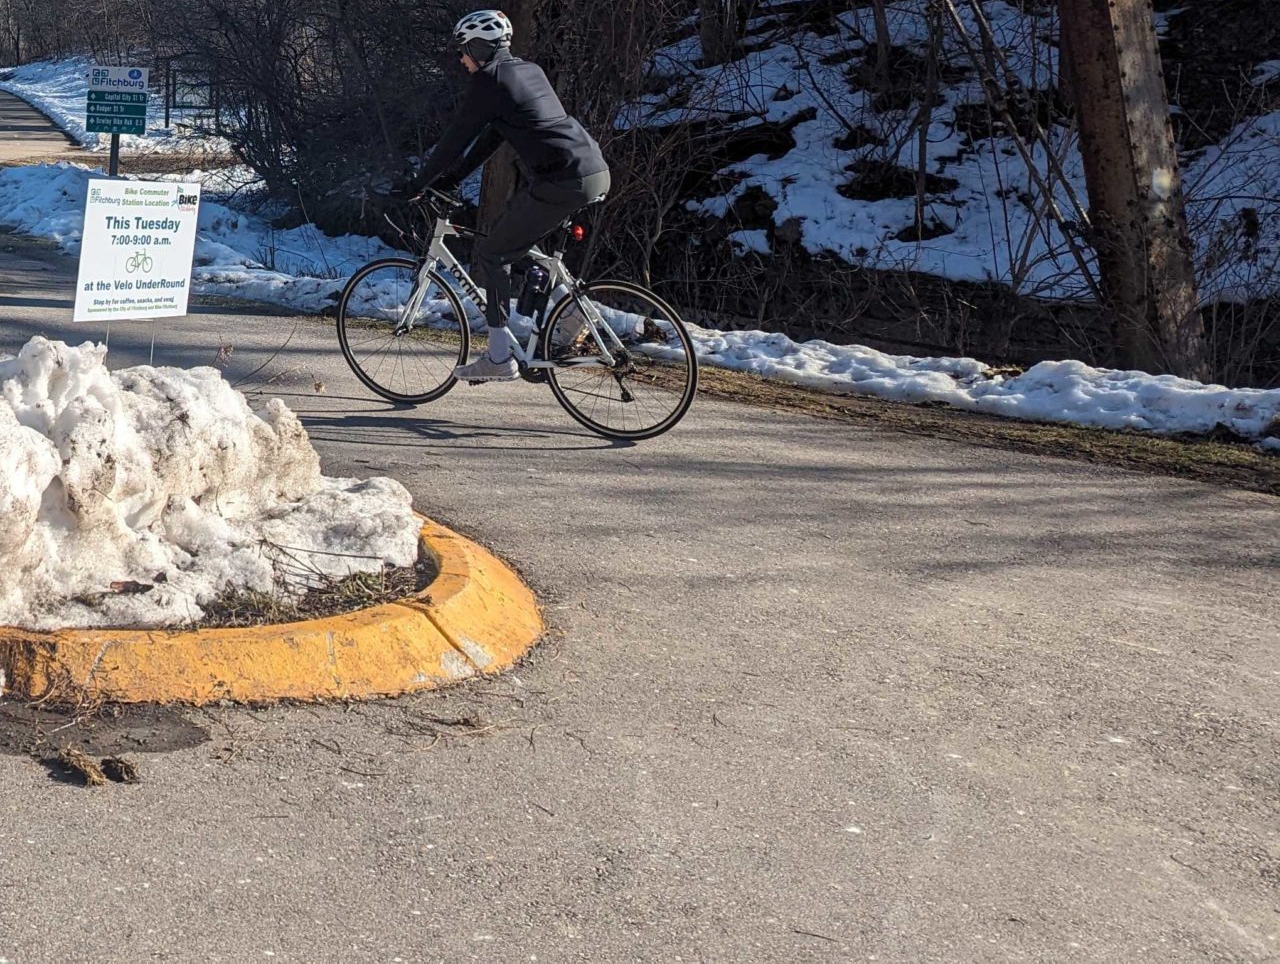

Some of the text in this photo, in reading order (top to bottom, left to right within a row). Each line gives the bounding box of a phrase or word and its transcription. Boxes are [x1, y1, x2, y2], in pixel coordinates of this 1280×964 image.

[100, 78, 144, 89] Fitchburg
[95, 197, 120, 206] Fitchburg
[179, 195, 197, 205] Bike
[106, 216, 181, 233] This Tuesday
[111, 235, 171, 245] 7:00-9:00 a.m.
[84, 278, 186, 291] at the Velo UnderRound
